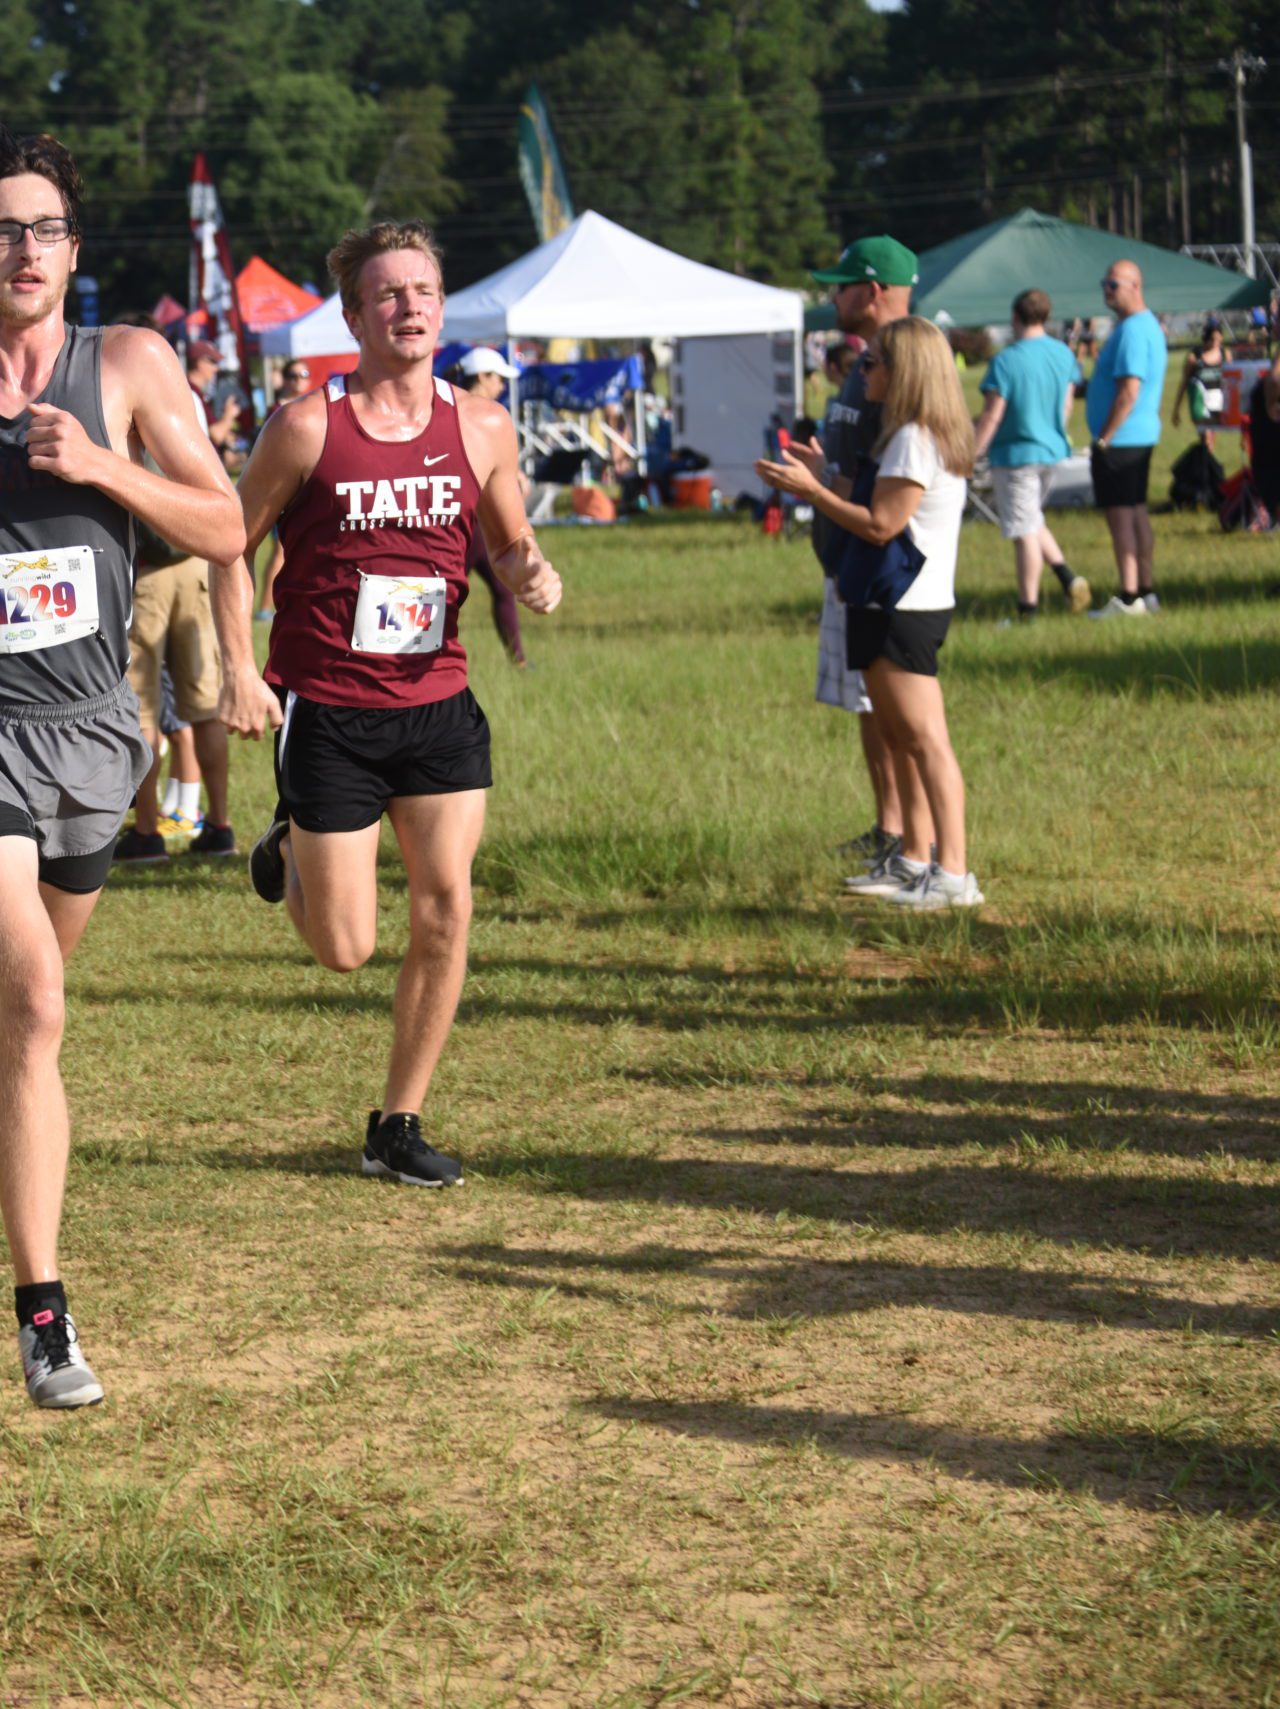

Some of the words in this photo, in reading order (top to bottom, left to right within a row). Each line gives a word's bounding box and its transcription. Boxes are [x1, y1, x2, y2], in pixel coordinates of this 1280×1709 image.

[335, 475, 462, 520] TATE
[339, 518, 387, 531] CROSS
[397, 514, 456, 529] COUNTRY
